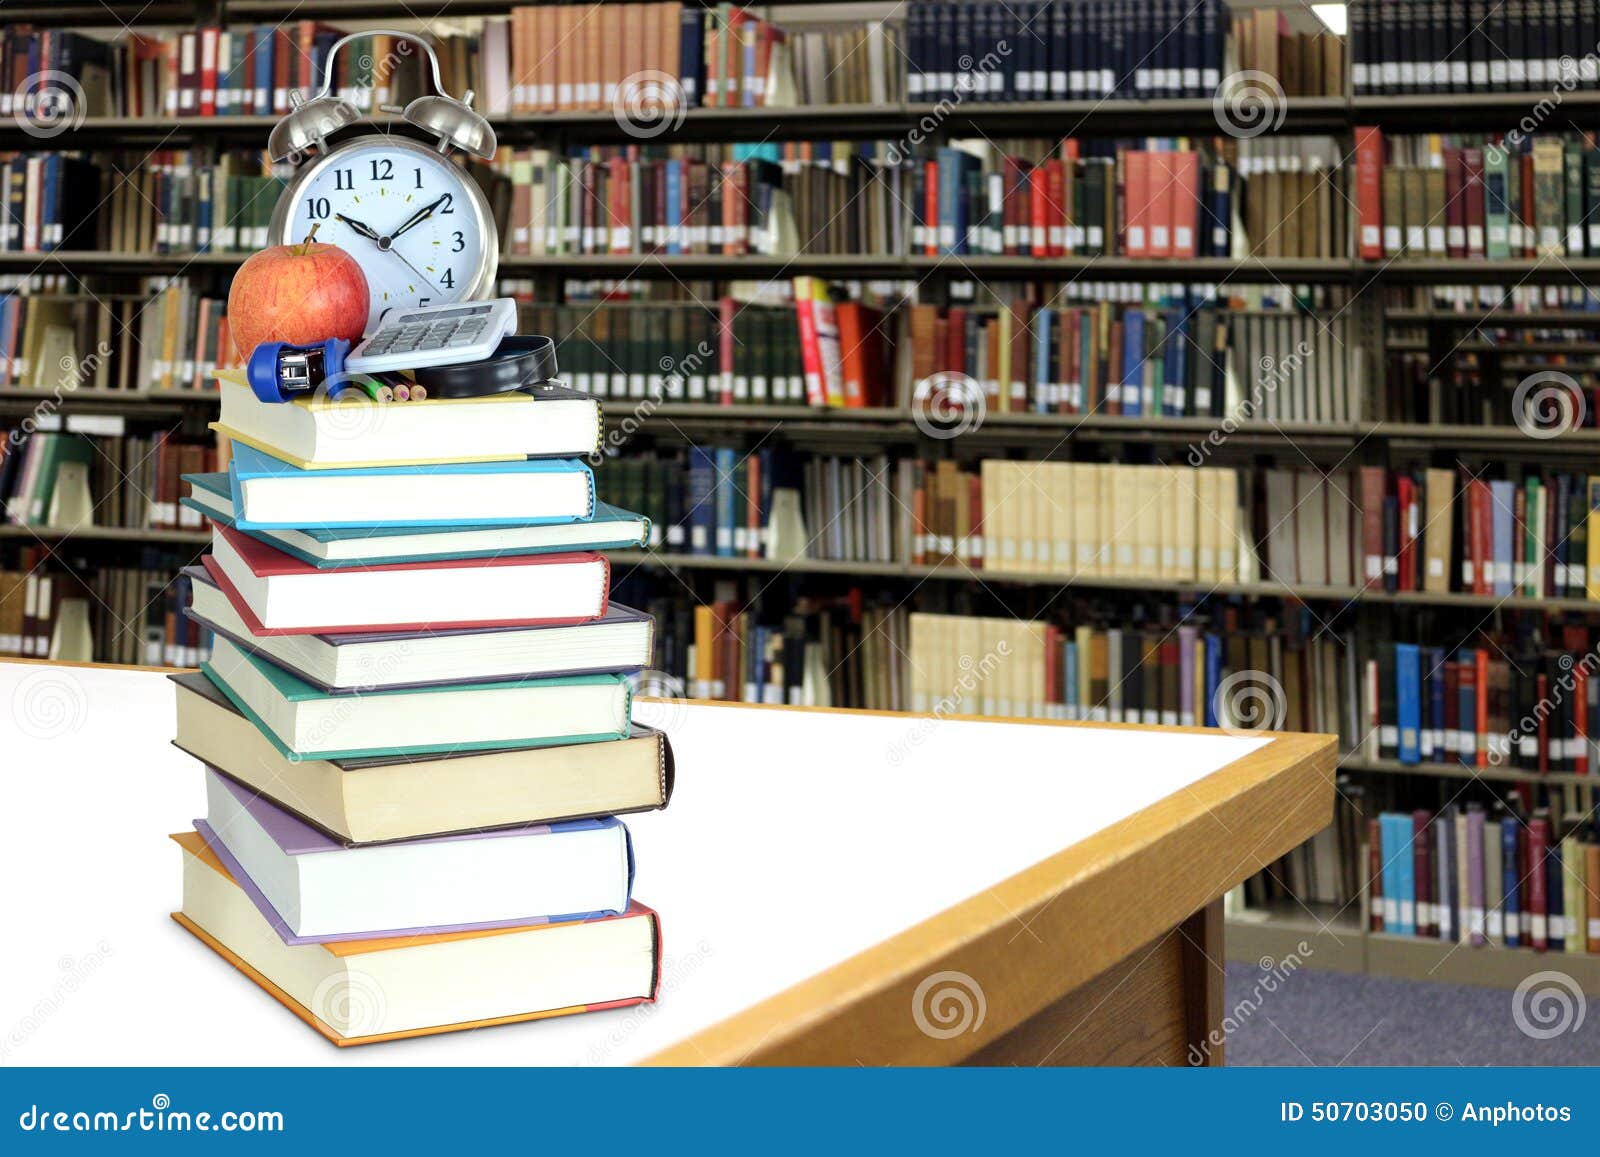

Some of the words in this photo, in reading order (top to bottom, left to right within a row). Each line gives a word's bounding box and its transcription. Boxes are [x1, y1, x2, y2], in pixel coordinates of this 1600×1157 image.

[334, 169, 355, 191] 11
[370, 159, 394, 181] 12
[414, 168, 424, 189] 1
[306, 197, 331, 219] 10
[440, 193, 455, 214] 2
[452, 231, 465, 252] 3
[439, 268, 455, 289] 4
